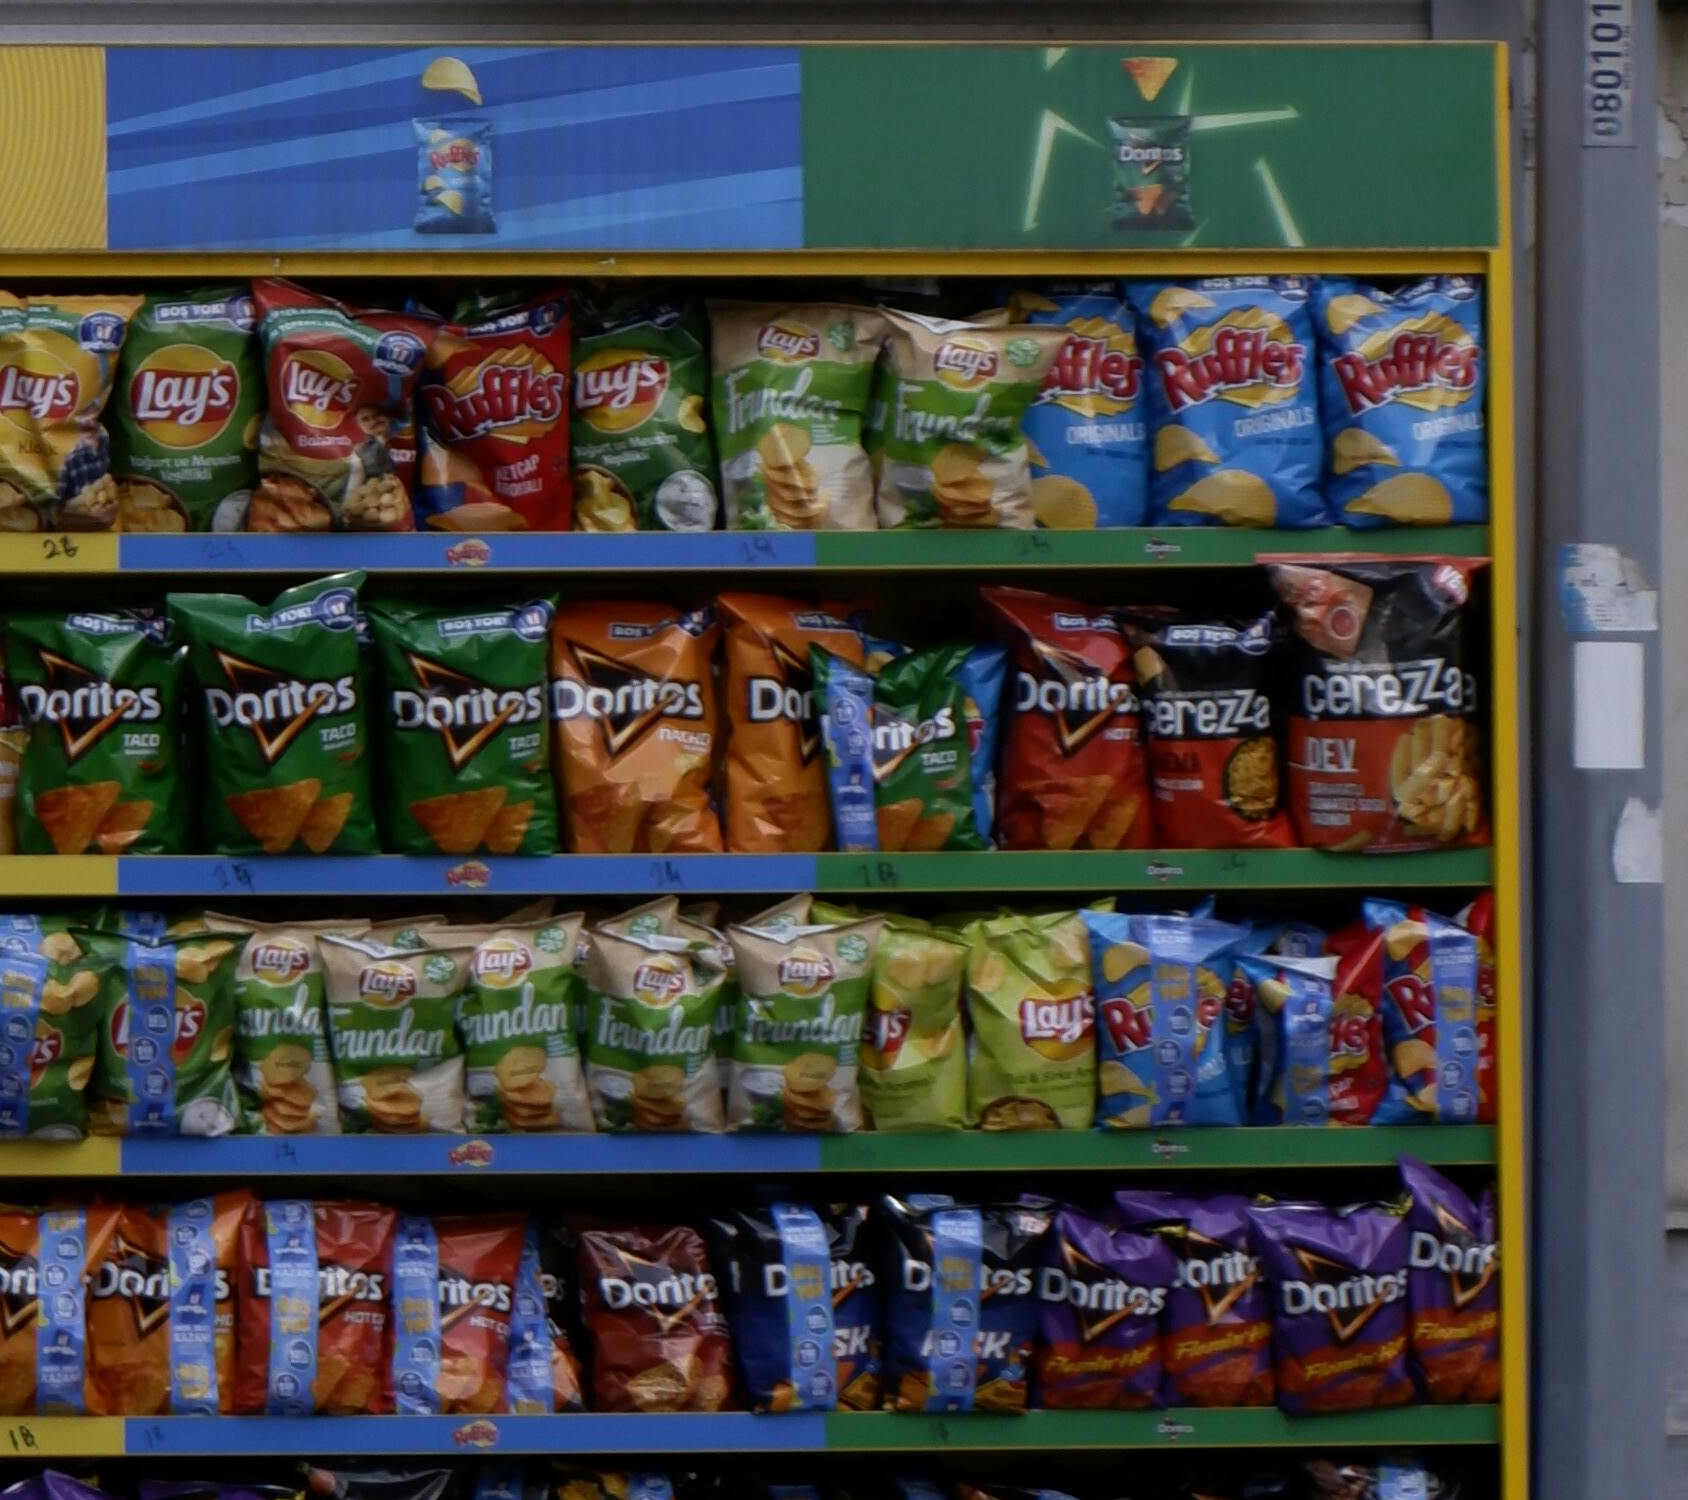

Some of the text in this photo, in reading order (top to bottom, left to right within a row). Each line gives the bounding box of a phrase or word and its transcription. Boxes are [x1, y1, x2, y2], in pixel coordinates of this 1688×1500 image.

[1155, 325, 1307, 414] Ruffles
[1332, 329, 1480, 417] Ruffles
[138, 367, 239, 427] Lay's
[1232, 405, 1314, 438] ORIGINALS
[19, 683, 162, 723] Doritos
[206, 676, 357, 727] Doritos
[393, 685, 542, 730] Doritos
[551, 679, 704, 722] Doritos
[123, 732, 160, 748] TACO
[320, 723, 357, 744] TACO
[509, 732, 541, 751] TACO
[1306, 737, 1356, 770] DEV
[921, 749, 957, 767] TACO
[1040, 1266, 1166, 1316] Doritos
[1281, 1268, 1408, 1315] Doritos
